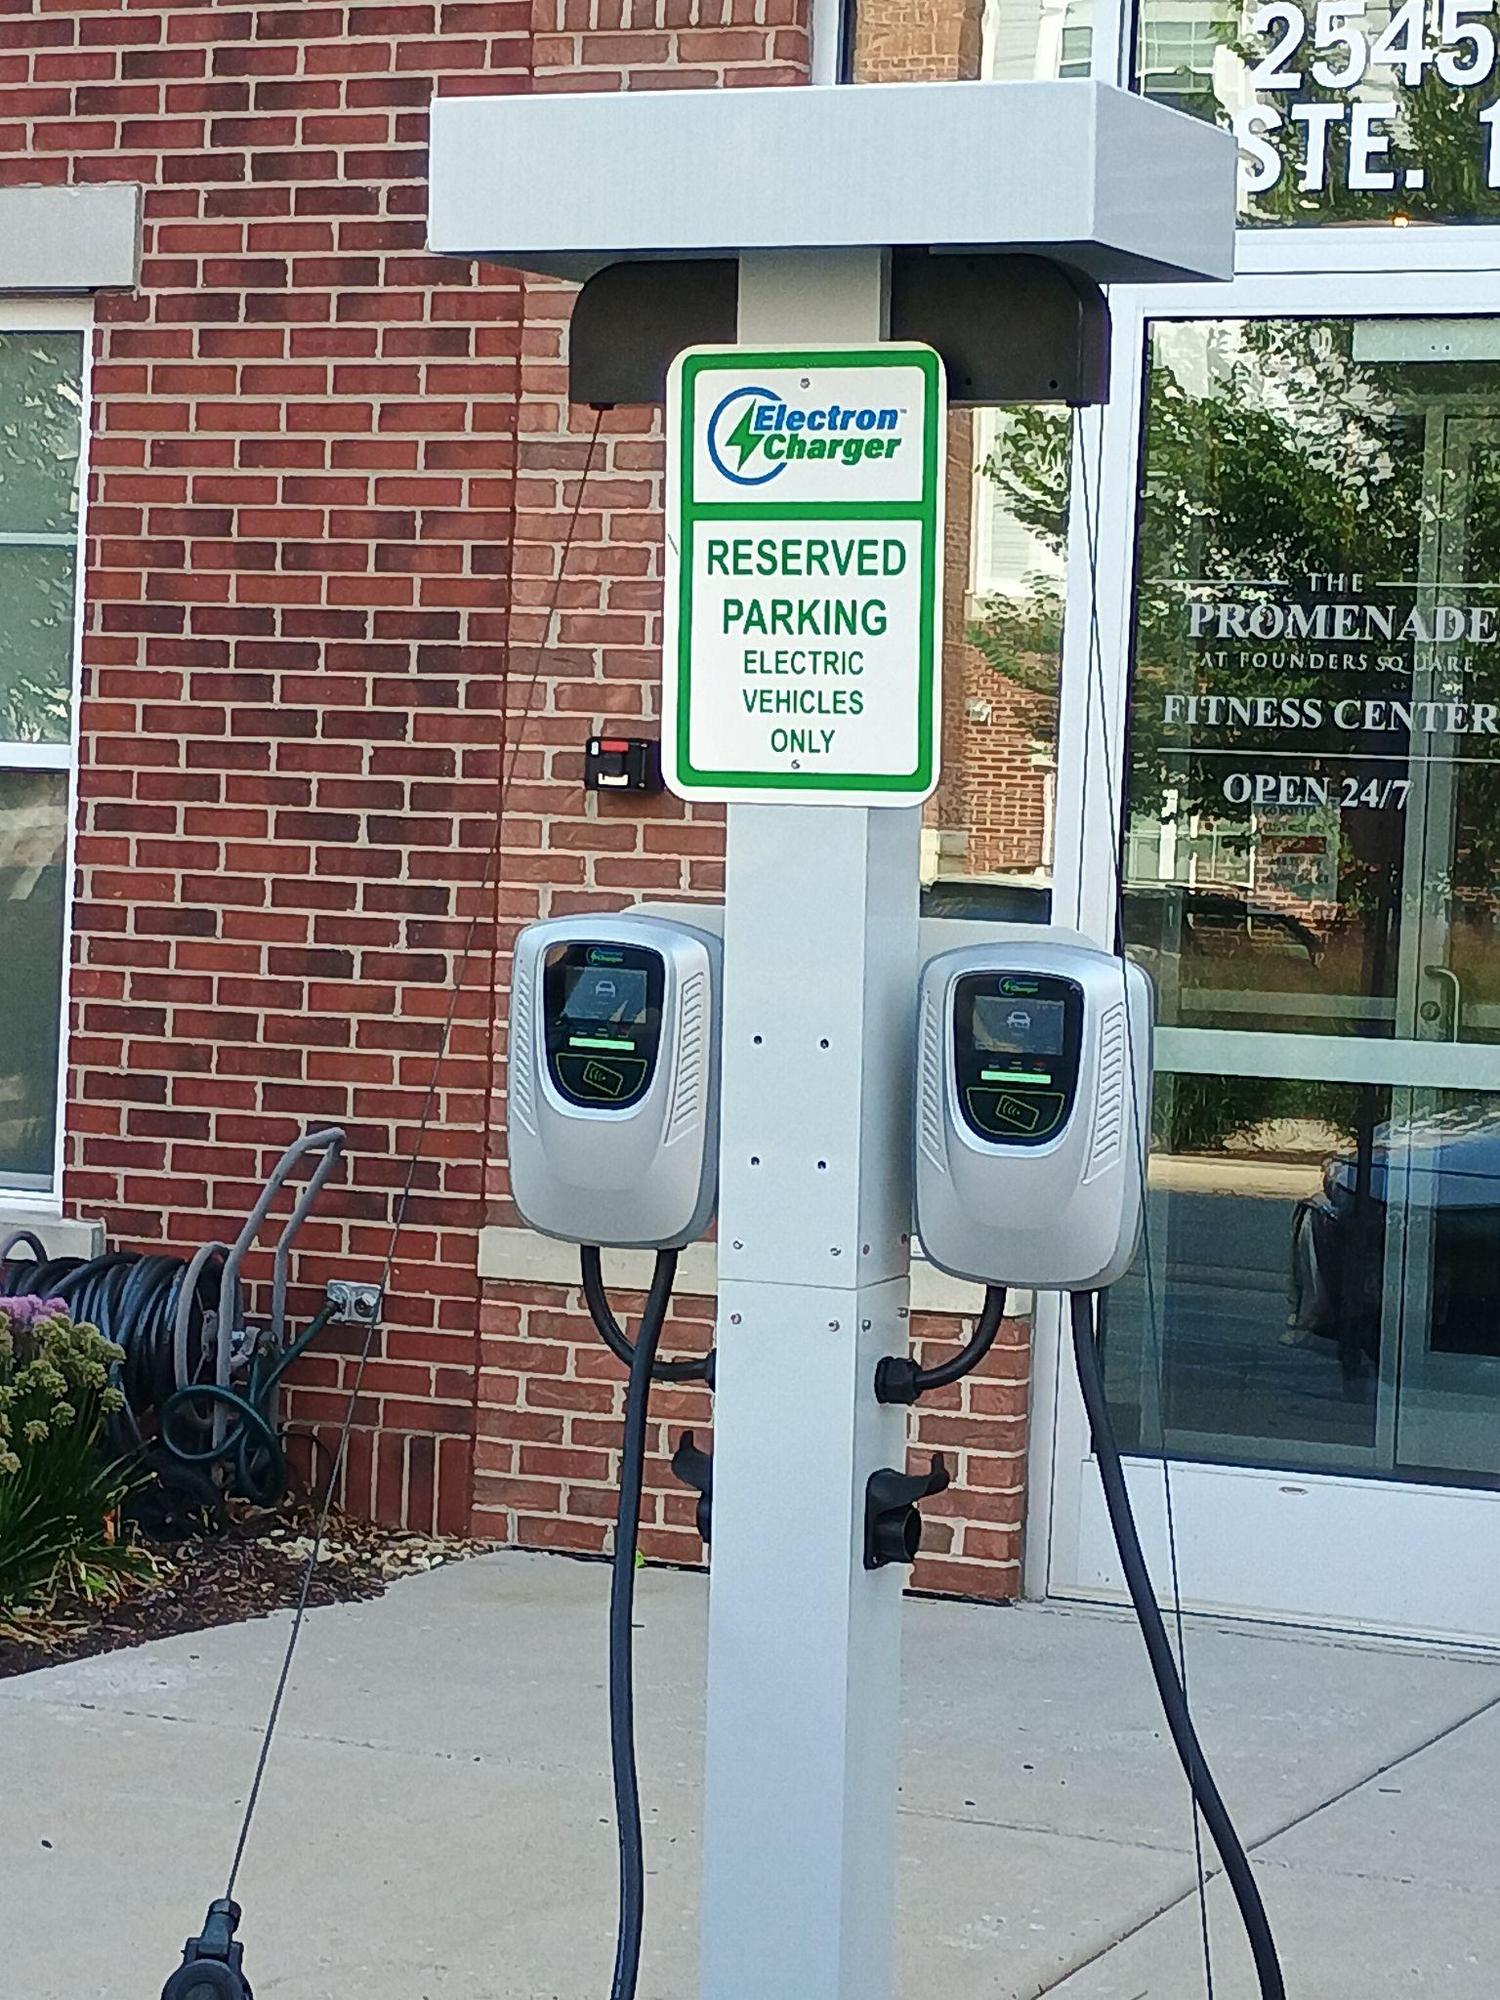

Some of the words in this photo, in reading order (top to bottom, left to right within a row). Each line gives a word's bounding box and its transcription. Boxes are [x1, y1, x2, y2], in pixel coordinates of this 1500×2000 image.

[1251, 0, 1494, 88] 2545
[1238, 101, 1424, 192] STE.
[754, 404, 899, 431] Electron
[763, 433, 902, 466] Charger
[707, 539, 907, 576] RESERVED
[1306, 573, 1364, 594] THE
[723, 598, 887, 636] PARKING
[1185, 602, 1499, 644] PROMENADE
[743, 650, 864, 675] ELECTRIC
[1200, 651, 1228, 668] AT
[1240, 651, 1369, 671] FOUNDERS
[1375, 655, 1474, 674] SQUARE
[742, 689, 864, 715] VEHICLES
[1162, 694, 1322, 729] FITNESS
[1334, 699, 1500, 734] CENTER
[771, 728, 835, 753] ONLY
[1223, 773, 1330, 805] OPEN
[1340, 777, 1413, 810] 24/7
